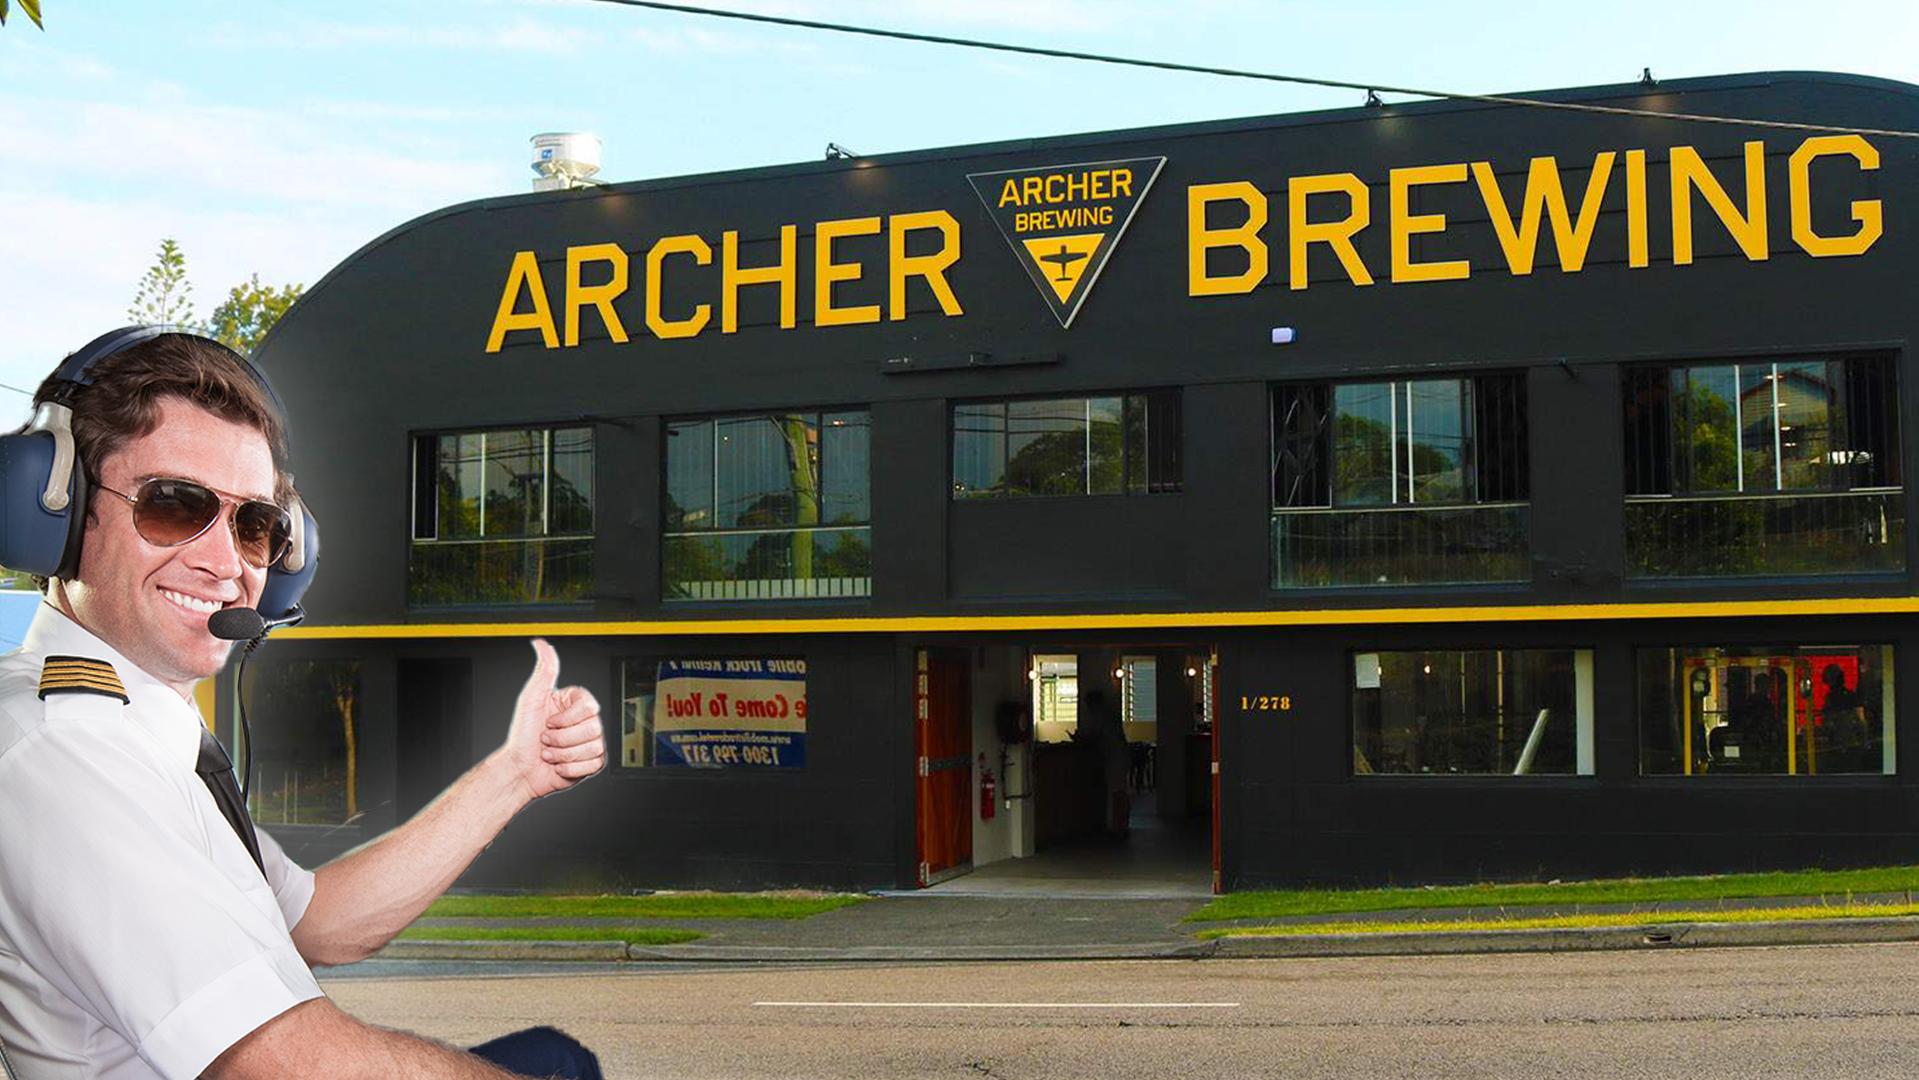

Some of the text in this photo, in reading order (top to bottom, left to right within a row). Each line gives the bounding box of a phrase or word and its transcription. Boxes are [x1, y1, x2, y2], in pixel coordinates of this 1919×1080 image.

[998, 168, 1133, 209] ARCHER
[1014, 205, 1113, 232] BREWING
[486, 135, 1883, 353] ARCHER BREWING
[1241, 696, 1291, 710] 1/278
